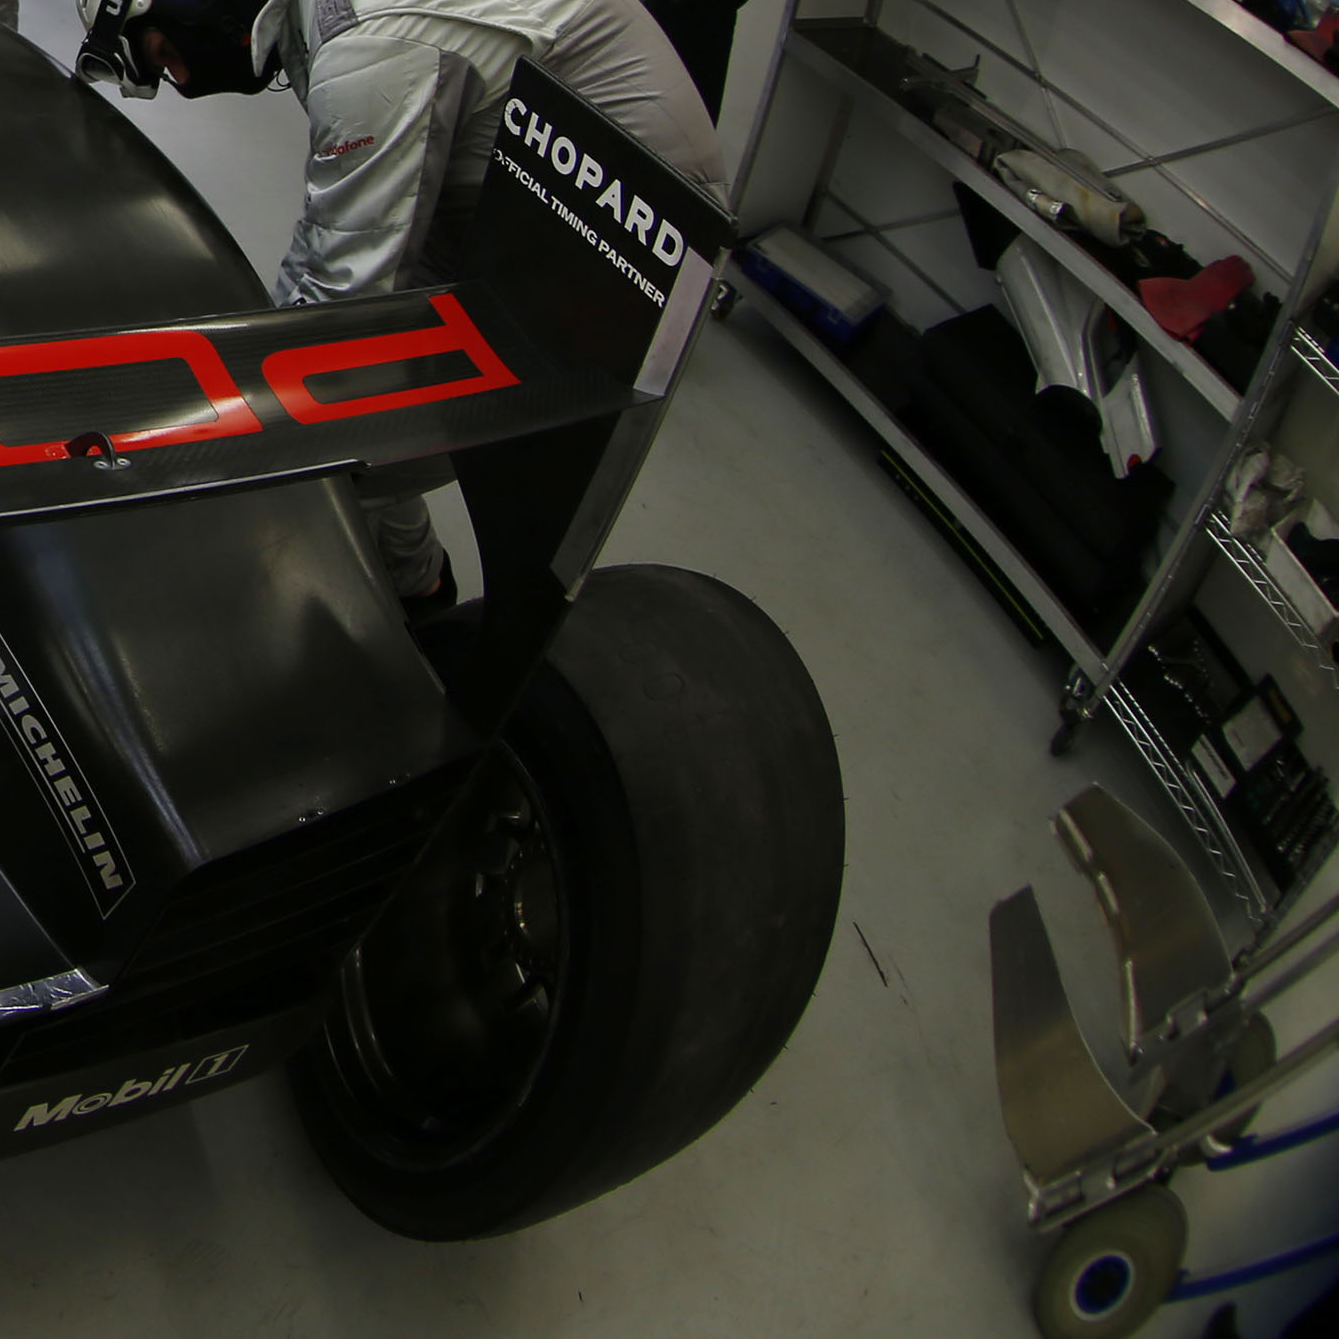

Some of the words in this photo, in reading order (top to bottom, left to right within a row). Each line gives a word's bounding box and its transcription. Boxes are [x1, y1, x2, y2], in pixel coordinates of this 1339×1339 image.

[504, 98, 684, 267] CHOPARD
[550, 195, 598, 246] TIMING
[598, 239, 667, 308] PARTNER
[13, 1062, 191, 1132] Mobil
